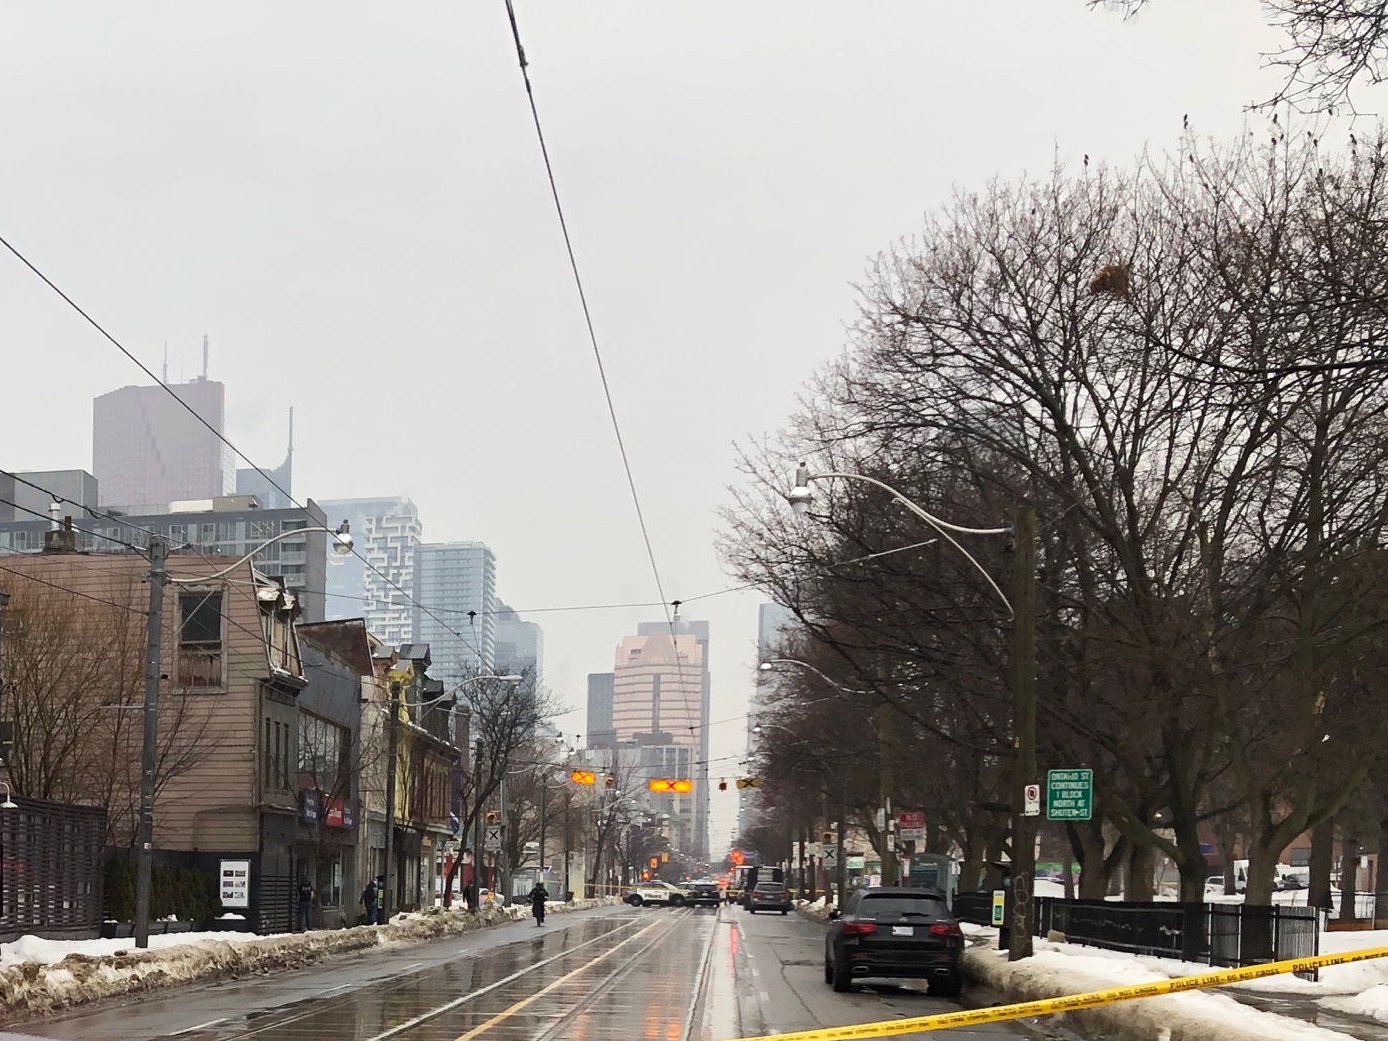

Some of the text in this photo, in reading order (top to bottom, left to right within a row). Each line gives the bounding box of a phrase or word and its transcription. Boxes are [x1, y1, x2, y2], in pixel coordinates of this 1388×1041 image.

[1051, 781, 1089, 790] CONTINUES
[1061, 790, 1083, 799] BLOCK
[1053, 800, 1075, 808] NORTH
[1293, 960, 1323, 972] POLICE
[1169, 977, 1200, 989] POLICE
[1240, 971, 1253, 979] NOT
[1255, 968, 1280, 977] CROSS
